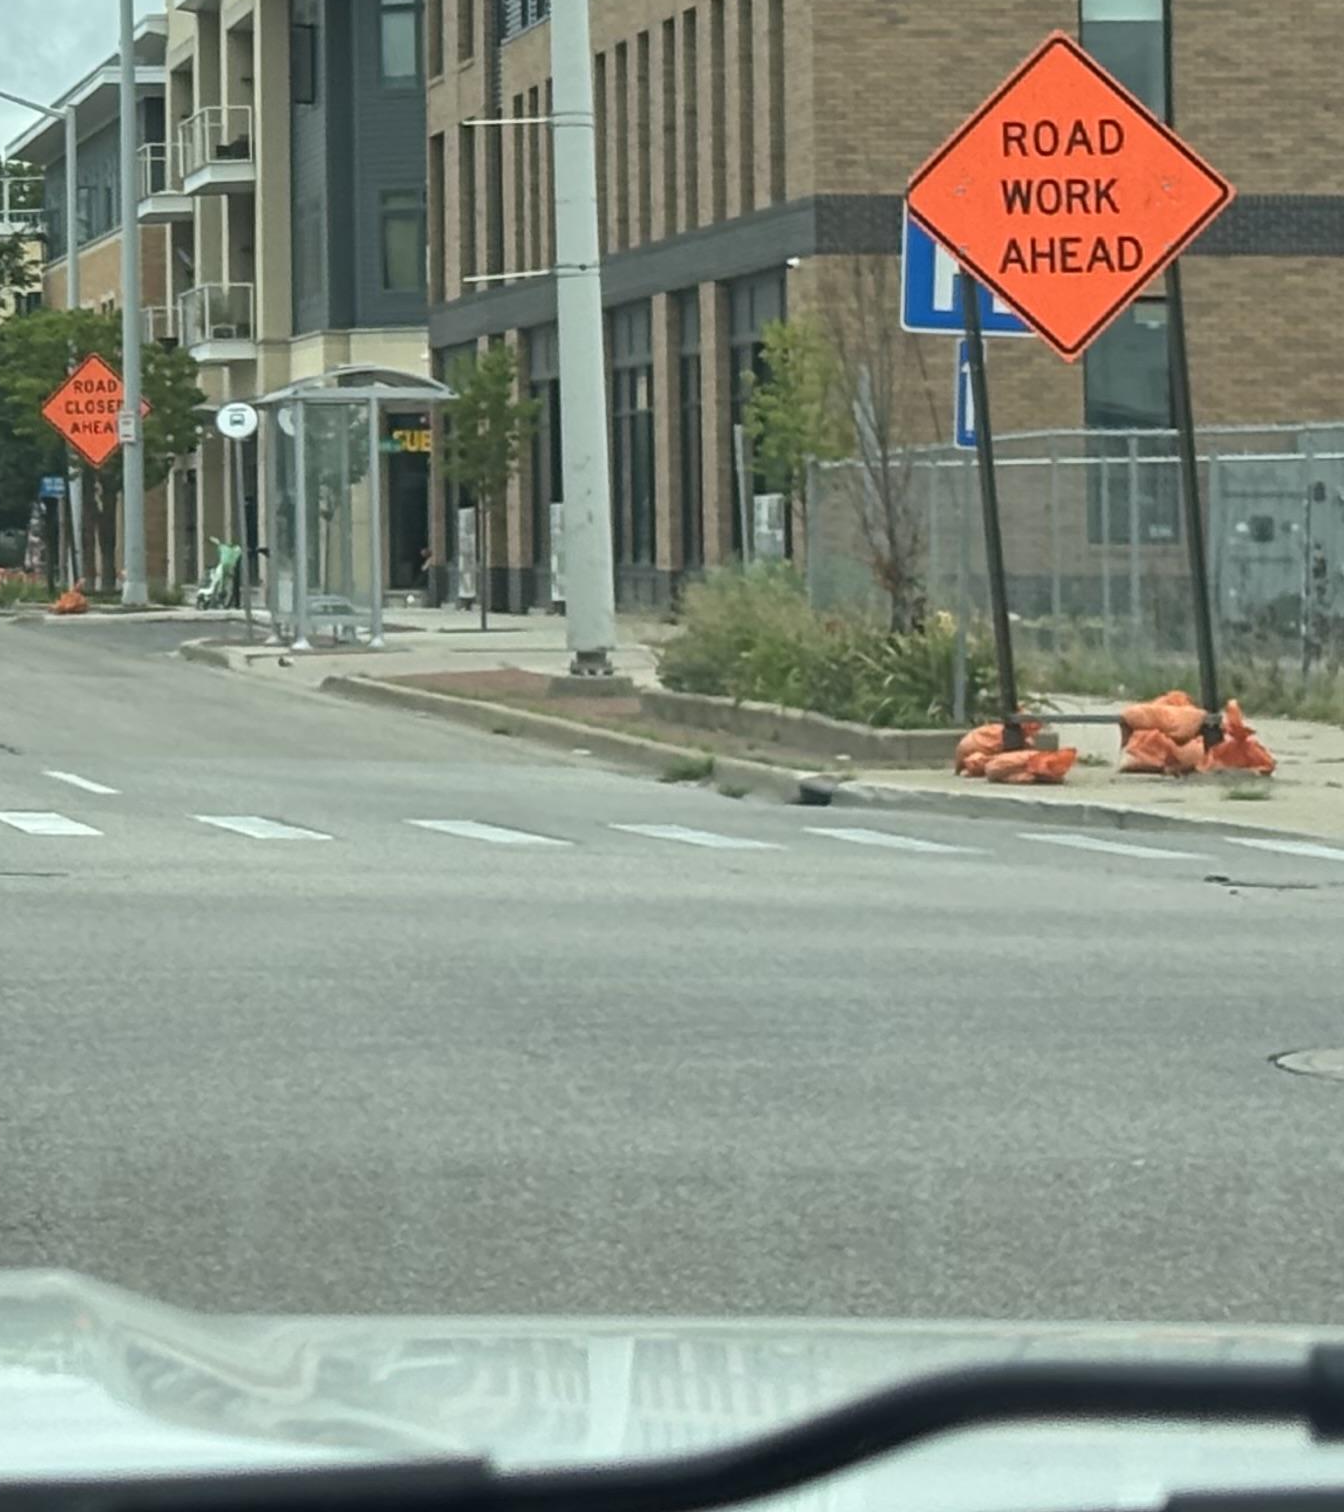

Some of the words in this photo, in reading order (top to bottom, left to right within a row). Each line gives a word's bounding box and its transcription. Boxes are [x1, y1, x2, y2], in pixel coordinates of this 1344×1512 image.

[1002, 119, 1125, 157] ROAD
[1001, 179, 1121, 216] WORK
[999, 236, 1144, 275] AHEAD
[73, 379, 117, 393] ROAD
[70, 420, 115, 434] AHEA
